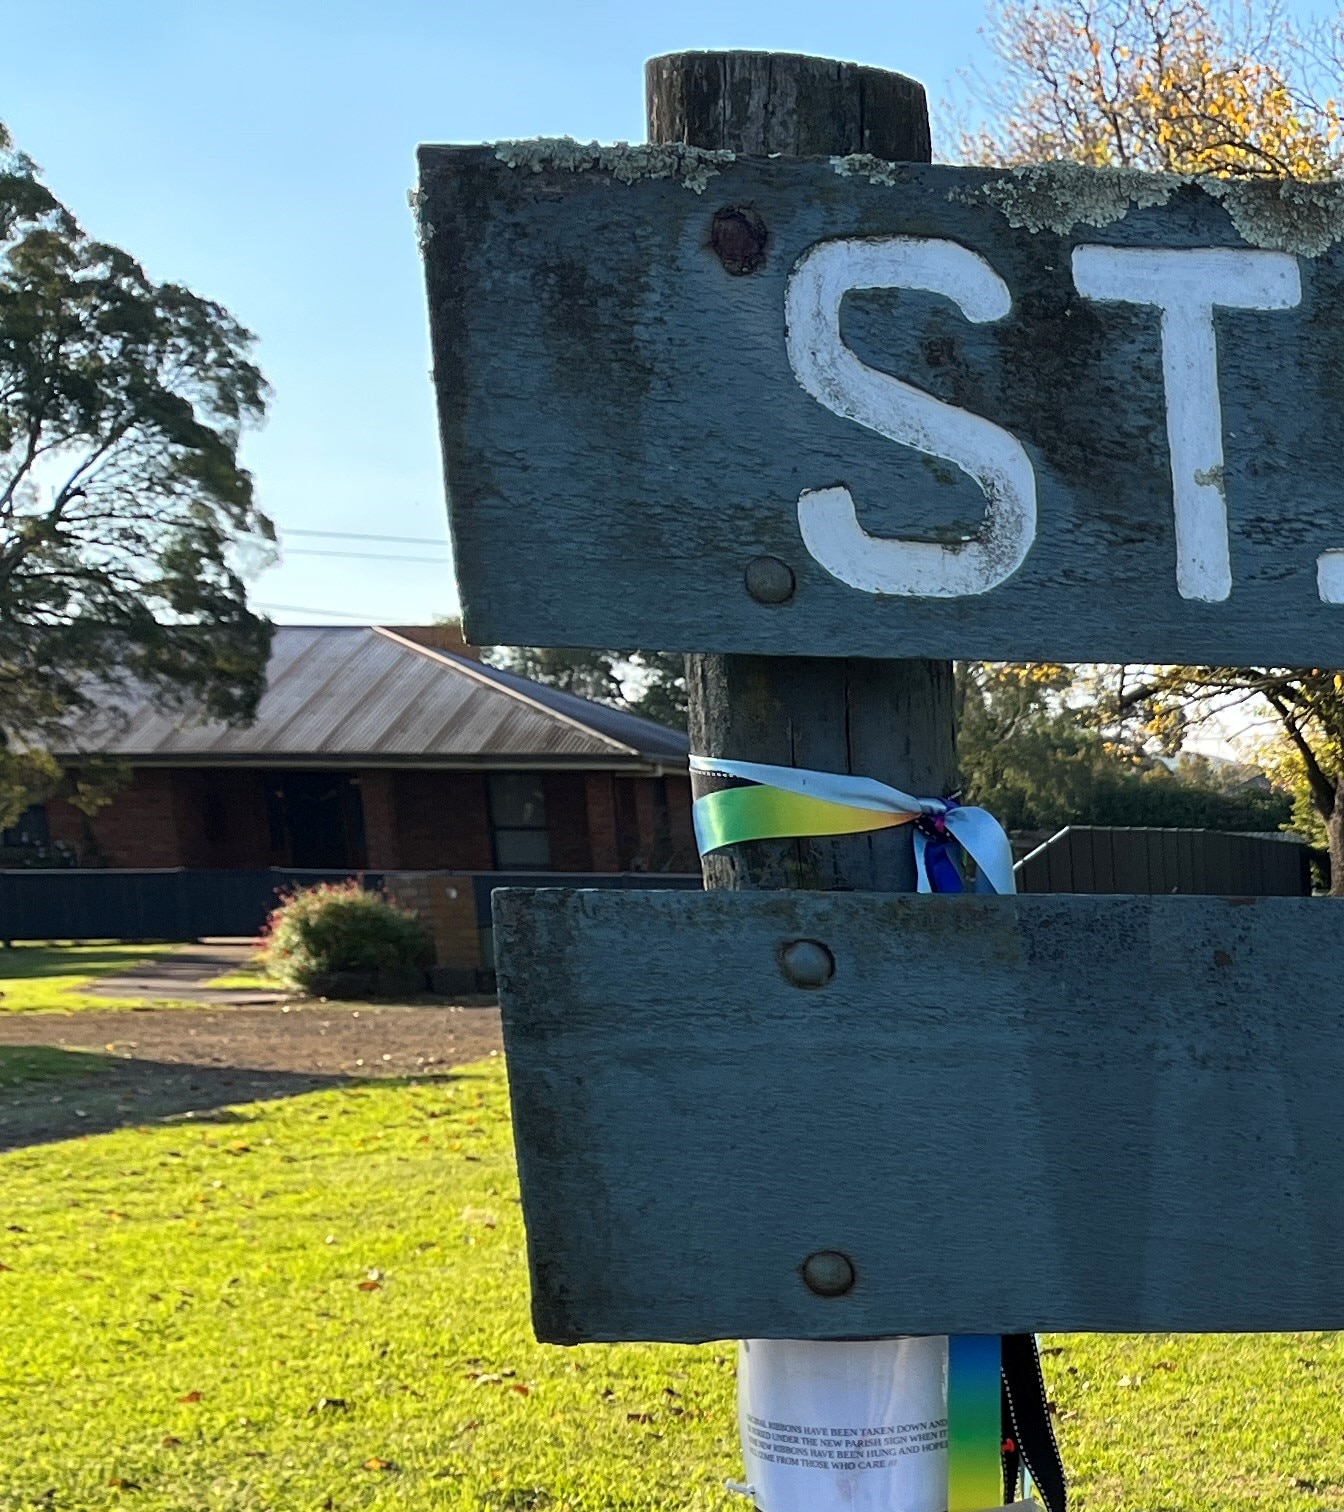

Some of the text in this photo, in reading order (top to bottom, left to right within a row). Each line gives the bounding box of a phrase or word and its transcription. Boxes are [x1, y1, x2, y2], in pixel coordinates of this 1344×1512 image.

[768, 1421, 802, 1434] RIBBONS
[804, 1426, 828, 1436] HAVE
[831, 1428, 858, 1437] BEEN
[860, 1426, 894, 1436] TAKEN
[897, 1422, 927, 1433] DOWN
[929, 1418, 948, 1429] AND
[772, 1432, 800, 1444] UNDER
[801, 1436, 818, 1447] THE
[820, 1439, 842, 1448] NEW
[845, 1438, 882, 1448] PARISH
[884, 1435, 908, 1446] SIGN
[909, 1431, 938, 1443] WHEN
[773, 1444, 809, 1457] RIBBONS
[810, 1449, 835, 1459] HAVE
[837, 1450, 863, 1459] BEEN
[866, 1448, 897, 1458] HUNG
[898, 1445, 920, 1456] AND
[776, 1455, 799, 1466] FROM
[800, 1458, 830, 1470] THOSE
[831, 1461, 856, 1470] WHO
[857, 1459, 886, 1469] CARE
